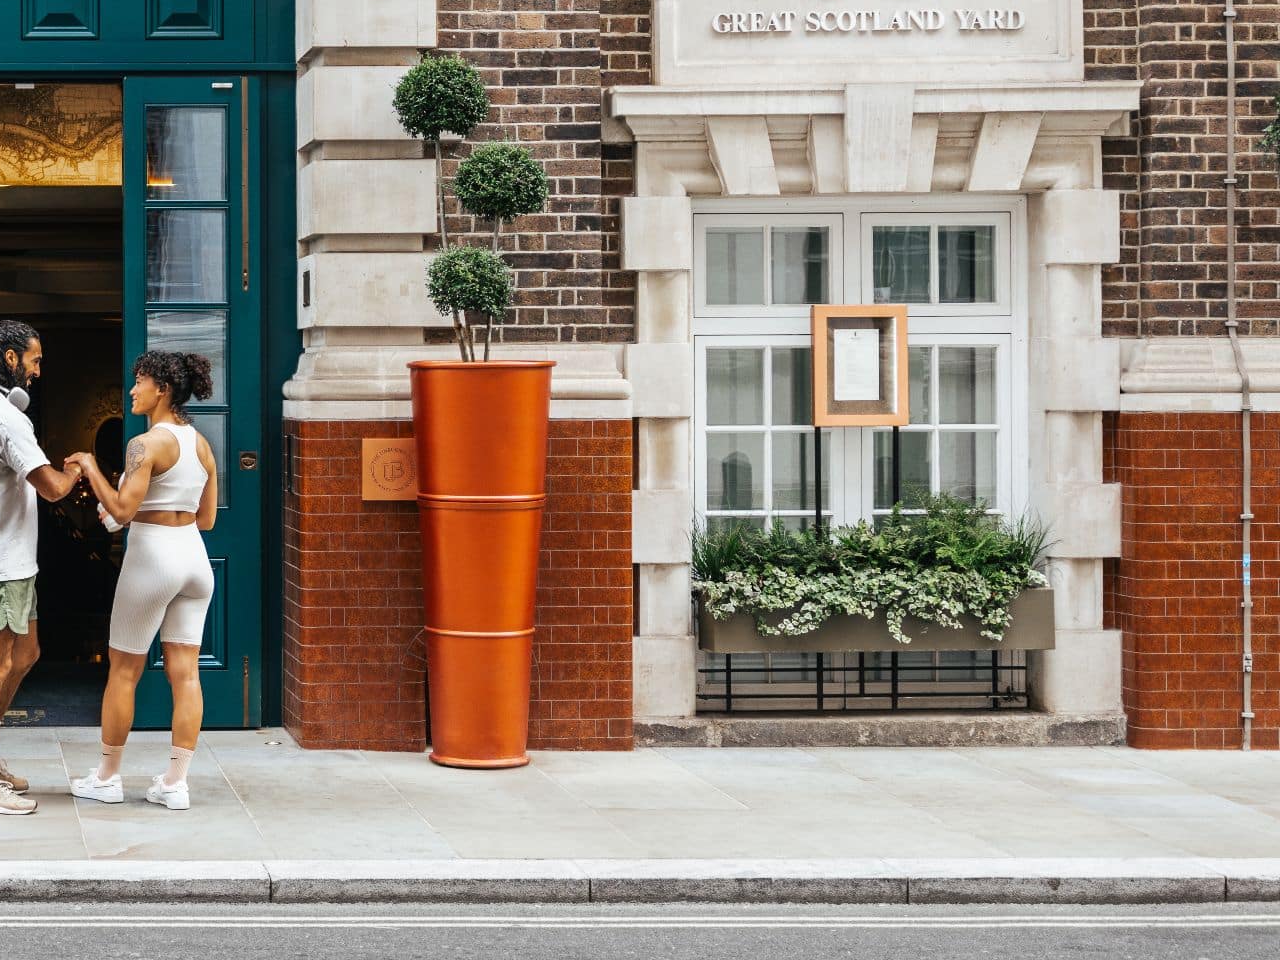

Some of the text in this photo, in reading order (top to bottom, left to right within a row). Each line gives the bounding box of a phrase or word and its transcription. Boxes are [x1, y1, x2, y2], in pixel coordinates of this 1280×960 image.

[711, 7, 1026, 34] GREAT SCOTLAND YARD
